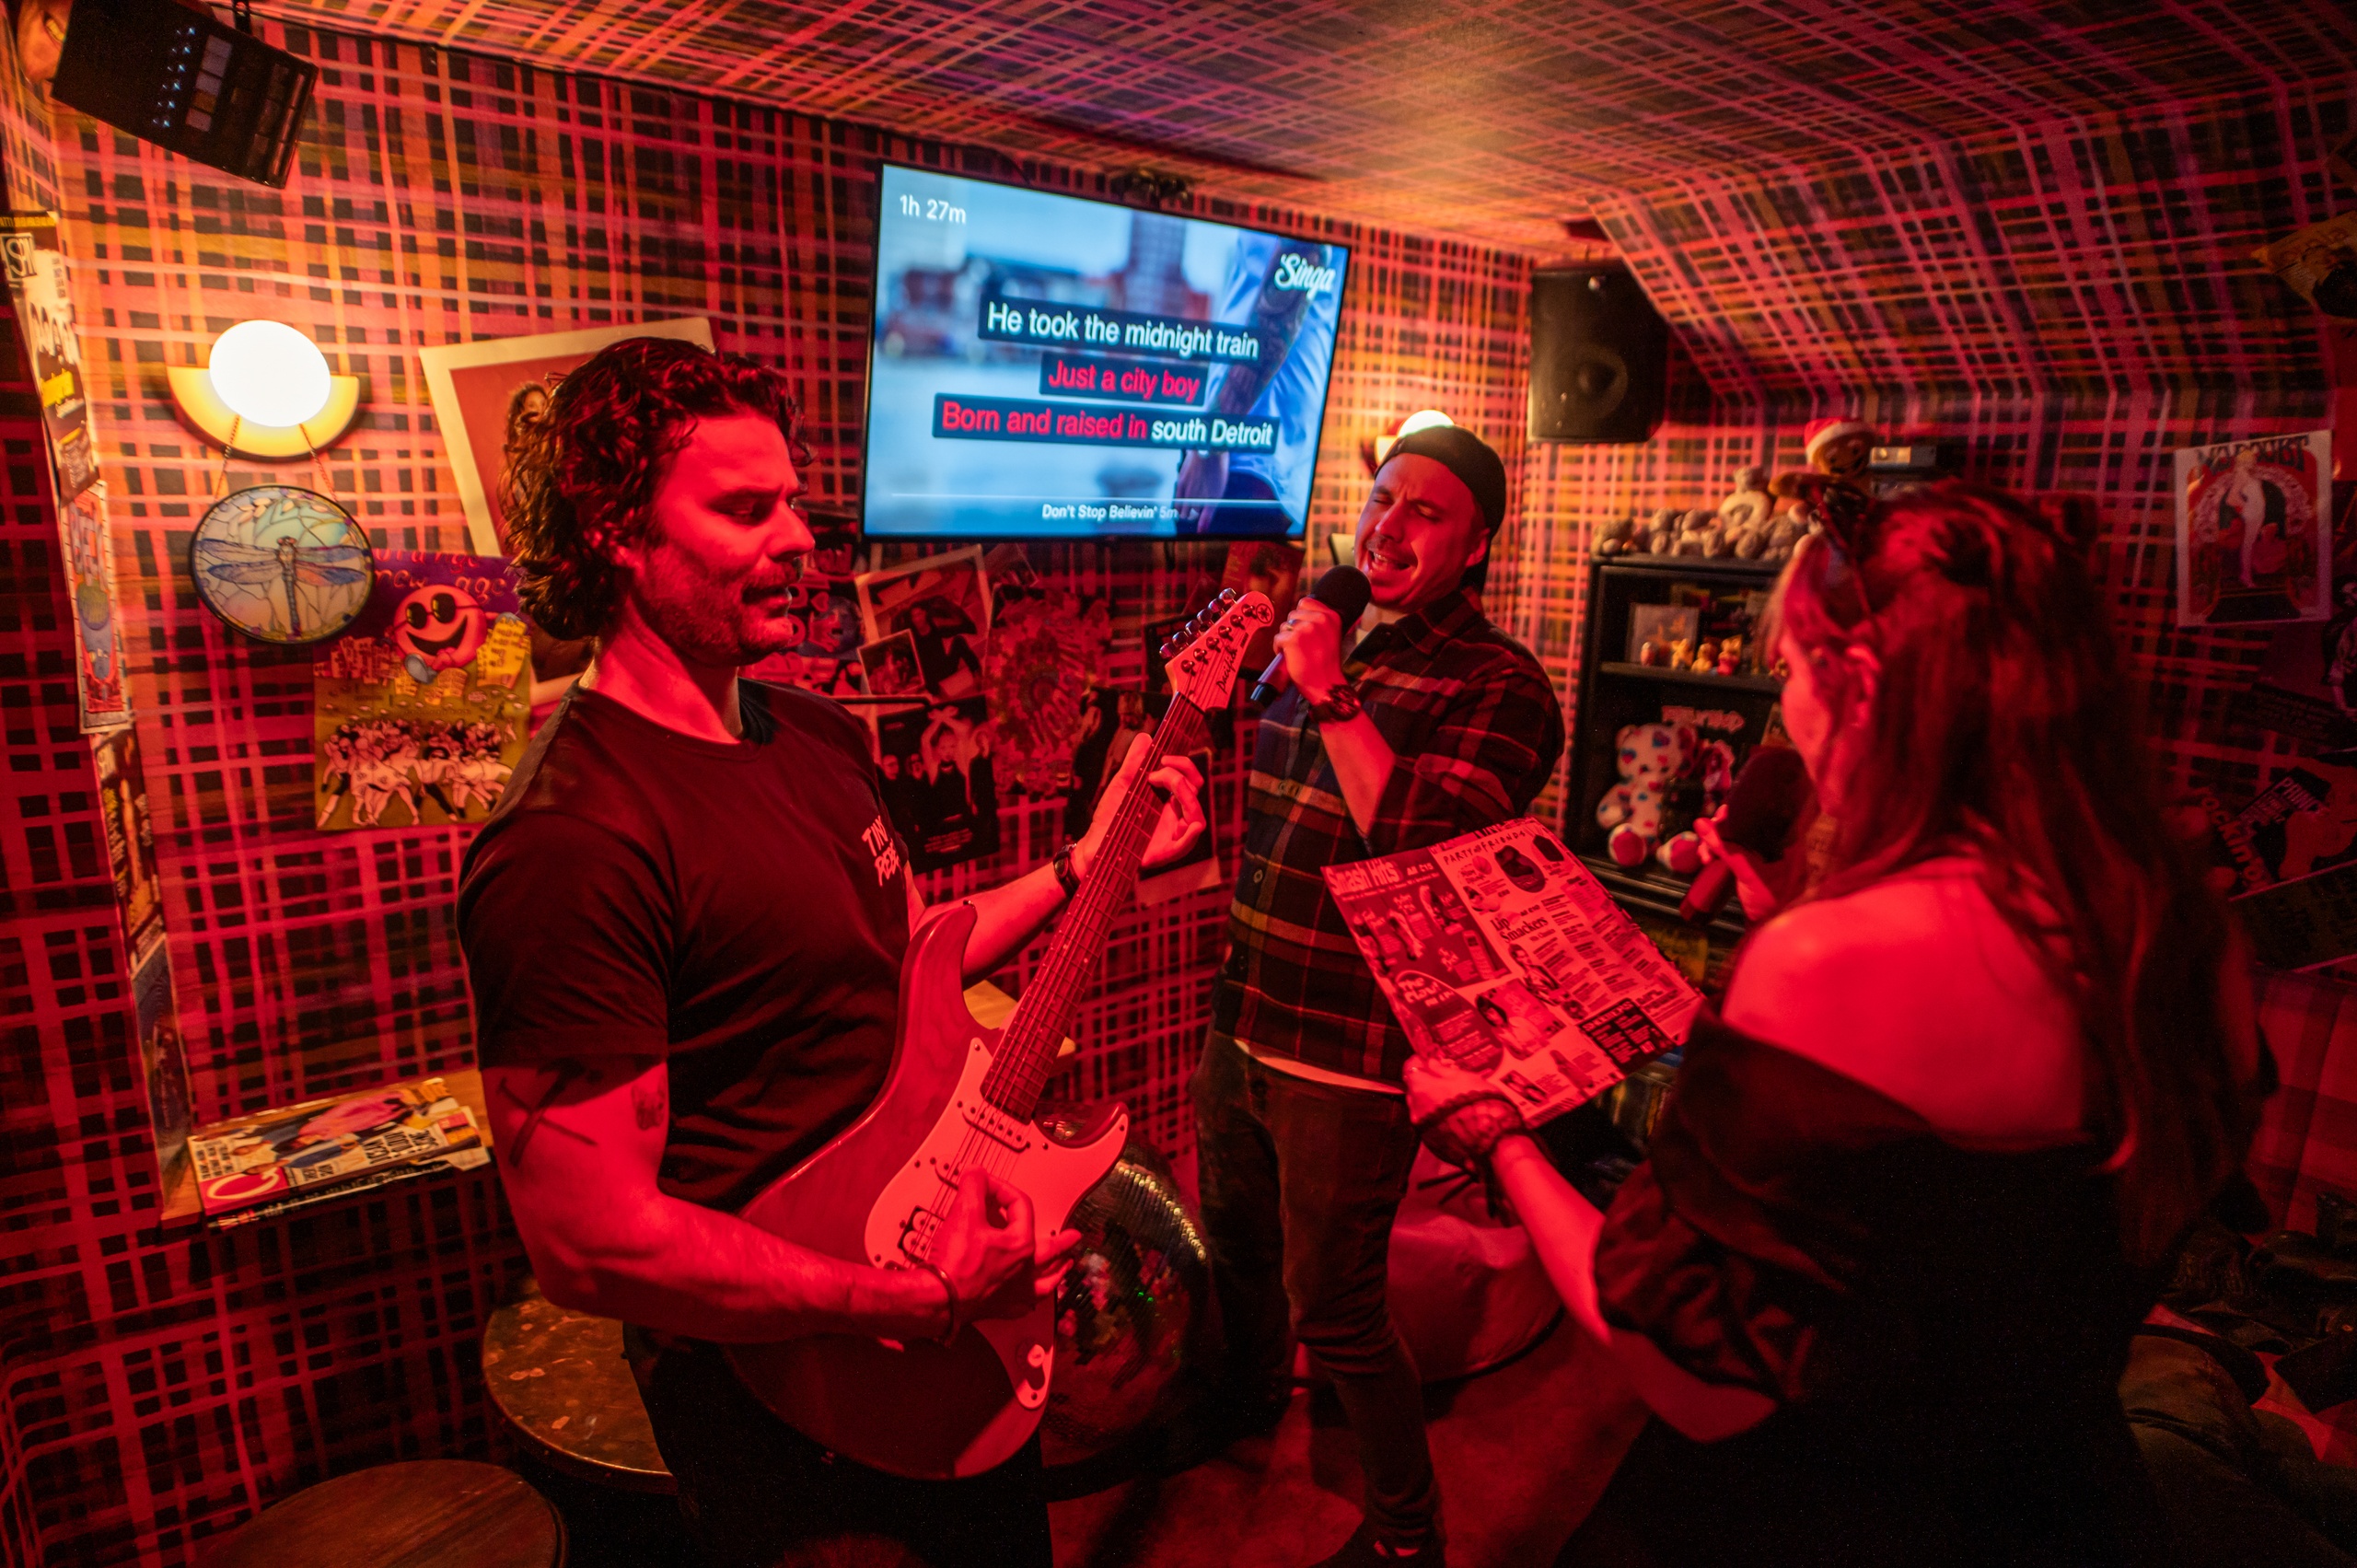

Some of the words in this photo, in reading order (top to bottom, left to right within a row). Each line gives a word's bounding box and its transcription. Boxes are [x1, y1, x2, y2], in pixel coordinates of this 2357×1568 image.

[899, 194, 920, 216] 1h
[926, 200, 966, 224] 27m
[1274, 253, 1336, 300] Singa
[987, 302, 1023, 332] He
[1029, 307, 1078, 340] took
[1086, 314, 1120, 345] the
[1125, 320, 1212, 357] midnight
[1216, 329, 1259, 359] train
[1049, 360, 1096, 389] Just
[1102, 371, 1116, 391] a
[1121, 366, 1158, 401] city
[1163, 369, 1200, 402] boy
[942, 401, 1000, 431] Born
[1007, 408, 1051, 434] and
[1057, 412, 1122, 438] raised
[1128, 416, 1147, 439] in
[1152, 418, 1205, 443] south
[1211, 418, 1273, 447] Detroit
[1042, 504, 1074, 518] Don't
[1077, 505, 1106, 520] Stop
[1109, 505, 1158, 519] Believin'
[456, 576, 507, 604] age
[862, 814, 888, 857] TIN
[1443, 849, 1474, 865] PARTY
[1327, 859, 1374, 893] Smash
[1370, 859, 1402, 885] Hits
[1490, 913, 1510, 934] Lip
[1499, 915, 1550, 945] Smackers
